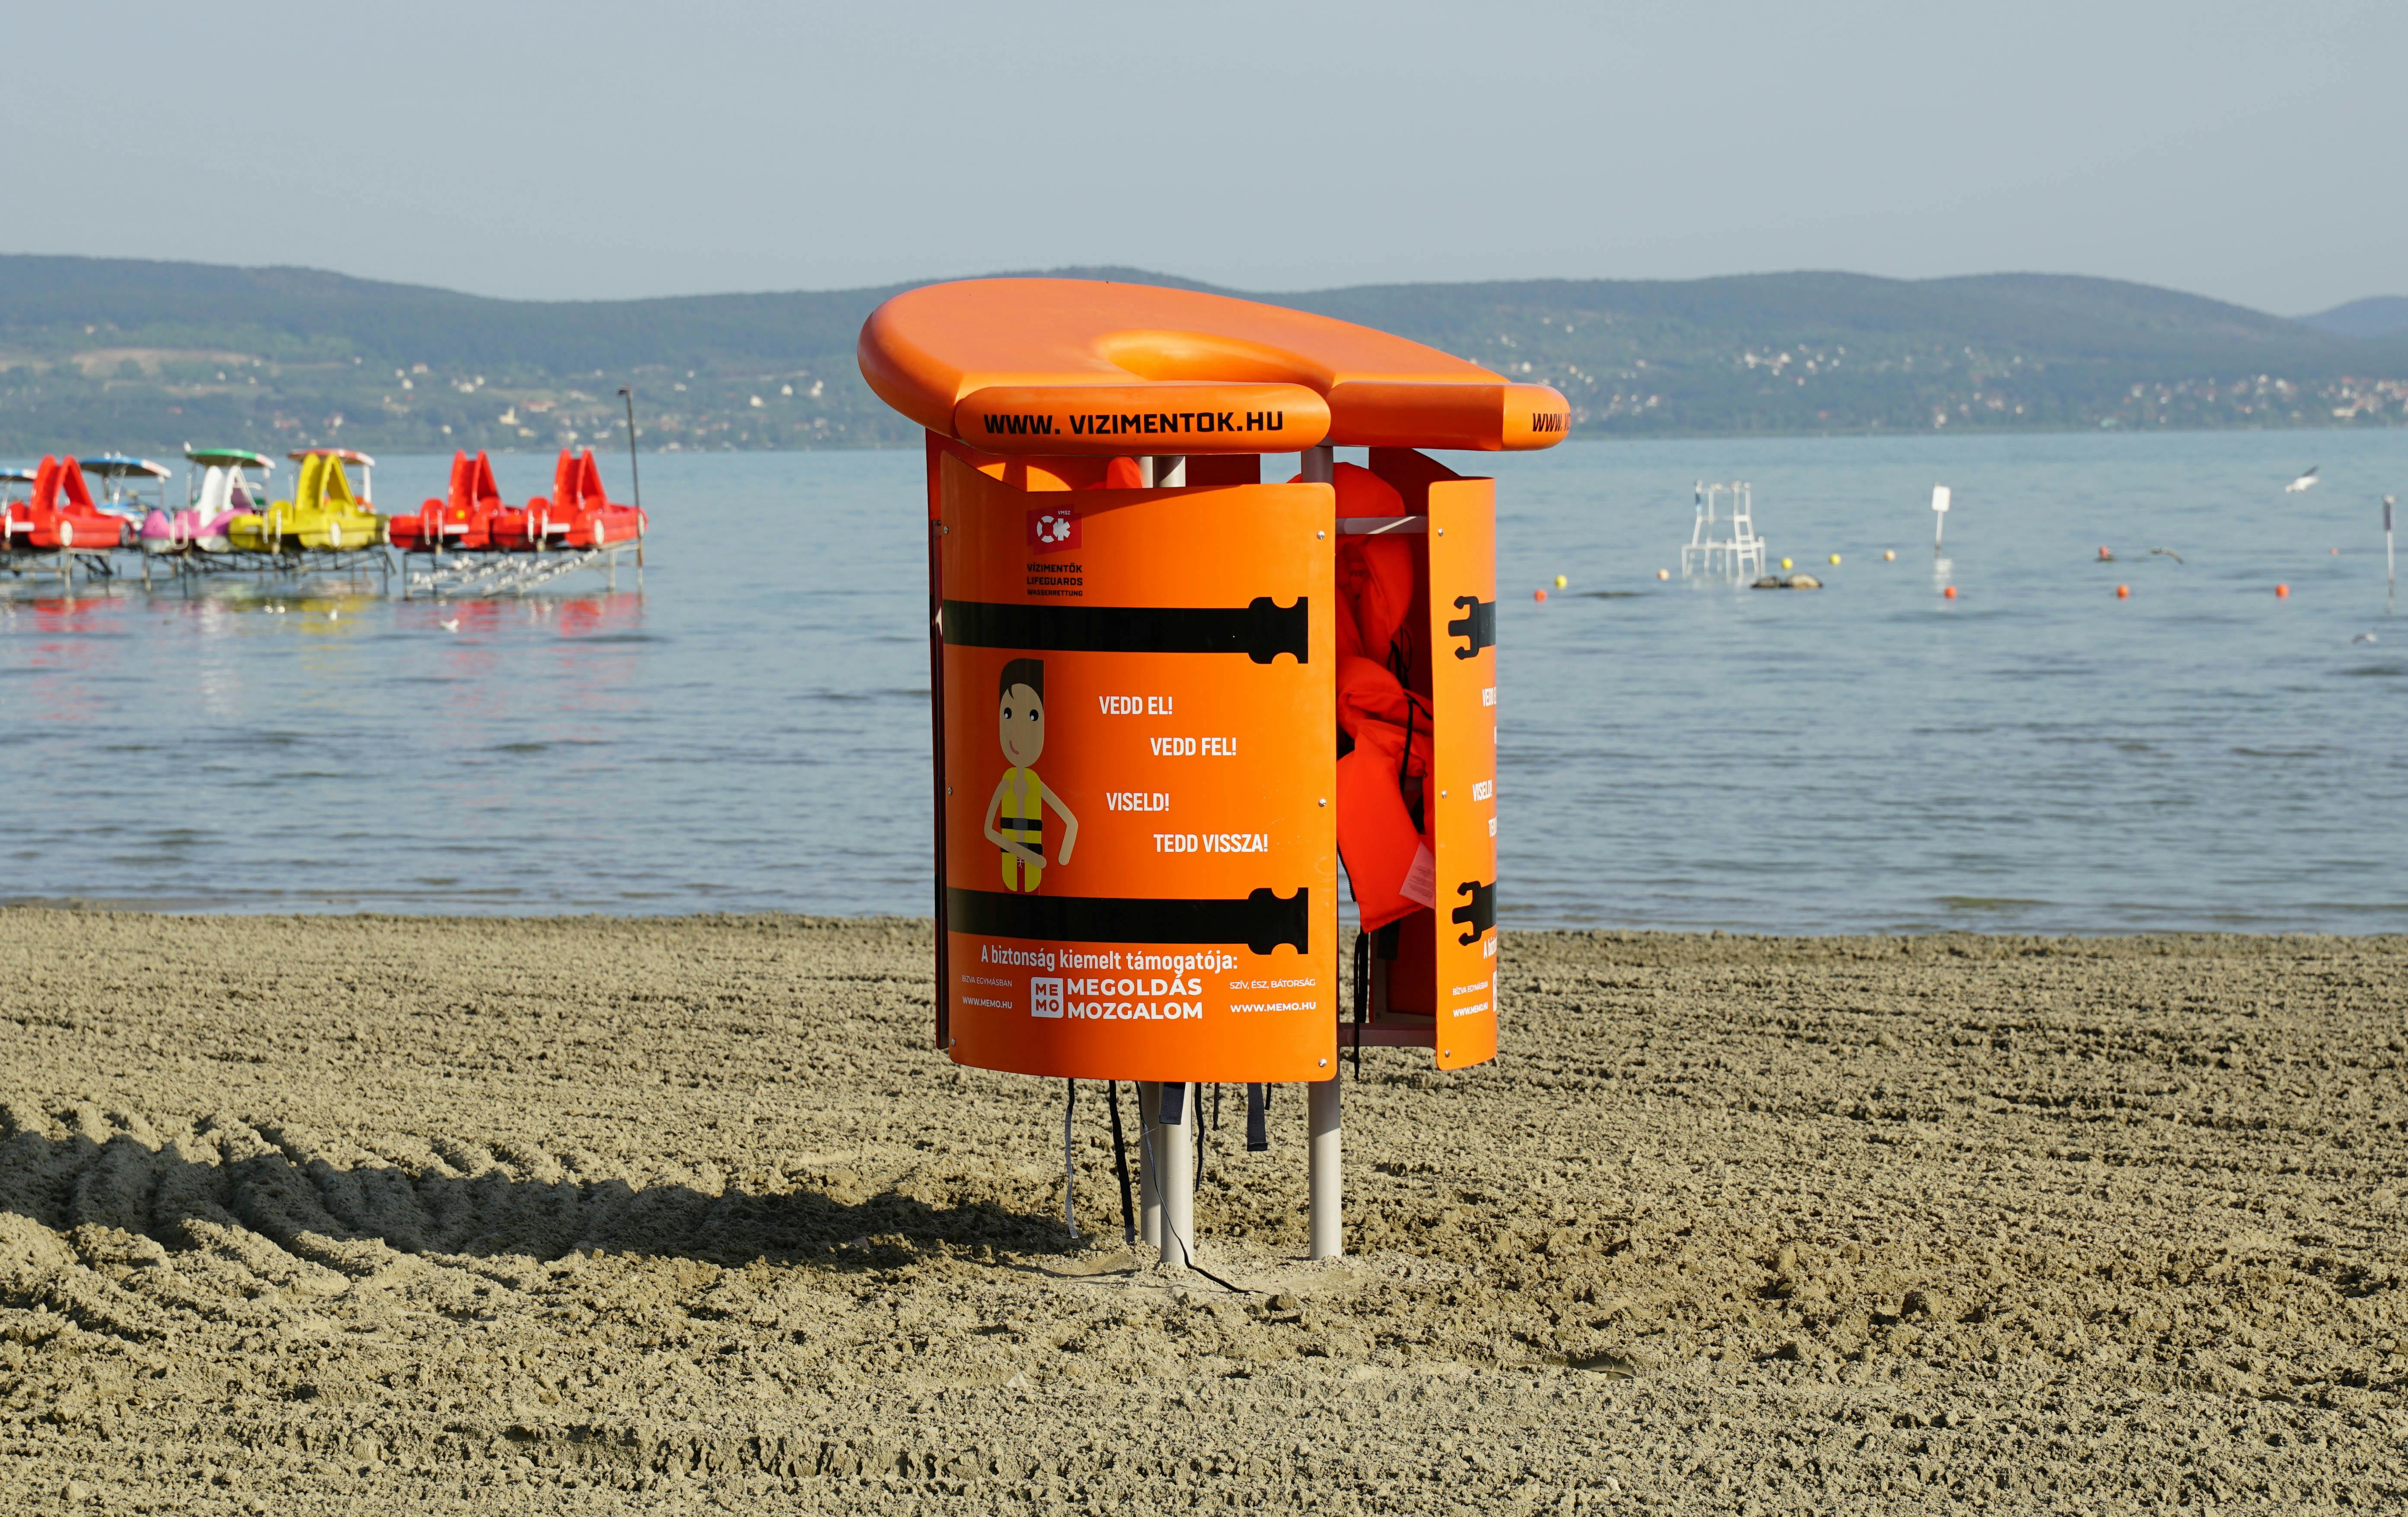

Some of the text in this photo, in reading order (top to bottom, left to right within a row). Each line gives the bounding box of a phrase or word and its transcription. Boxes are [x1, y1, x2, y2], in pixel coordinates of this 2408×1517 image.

[983, 411, 1283, 435] WWW. VIZIMENTOK.HU
[1027, 562, 1082, 573] VÍZIMENTŐK
[1027, 576, 1083, 586] LIFEGUARDS
[1099, 696, 1173, 715] VEDD EL!
[1150, 737, 1237, 756] VEDD FEL!
[1472, 779, 1492, 802] VISELD!
[1106, 792, 1169, 812] VISELD!
[1153, 834, 1268, 852] TEDD VISSZA!
[981, 944, 1238, 974] A biztonság kiemelt támogatója:
[977, 977, 1012, 987] EGYMÁSBAN
[1035, 983, 1058, 996] ME
[1067, 974, 1202, 996] MEGOLDÁS
[1229, 977, 1316, 990] SZÍV, ÉSZ, BÁTORSÁG
[1453, 985, 1467, 996] BÍZVA
[962, 996, 1012, 1009] WWW.MEMO.HU
[1036, 999, 1059, 1012] MO
[1230, 1001, 1316, 1013] WWW.MEMO.HU
[1453, 1002, 1489, 1017] WWW.MEMO.HU
[1068, 1002, 1203, 1020] MOZGALOM
